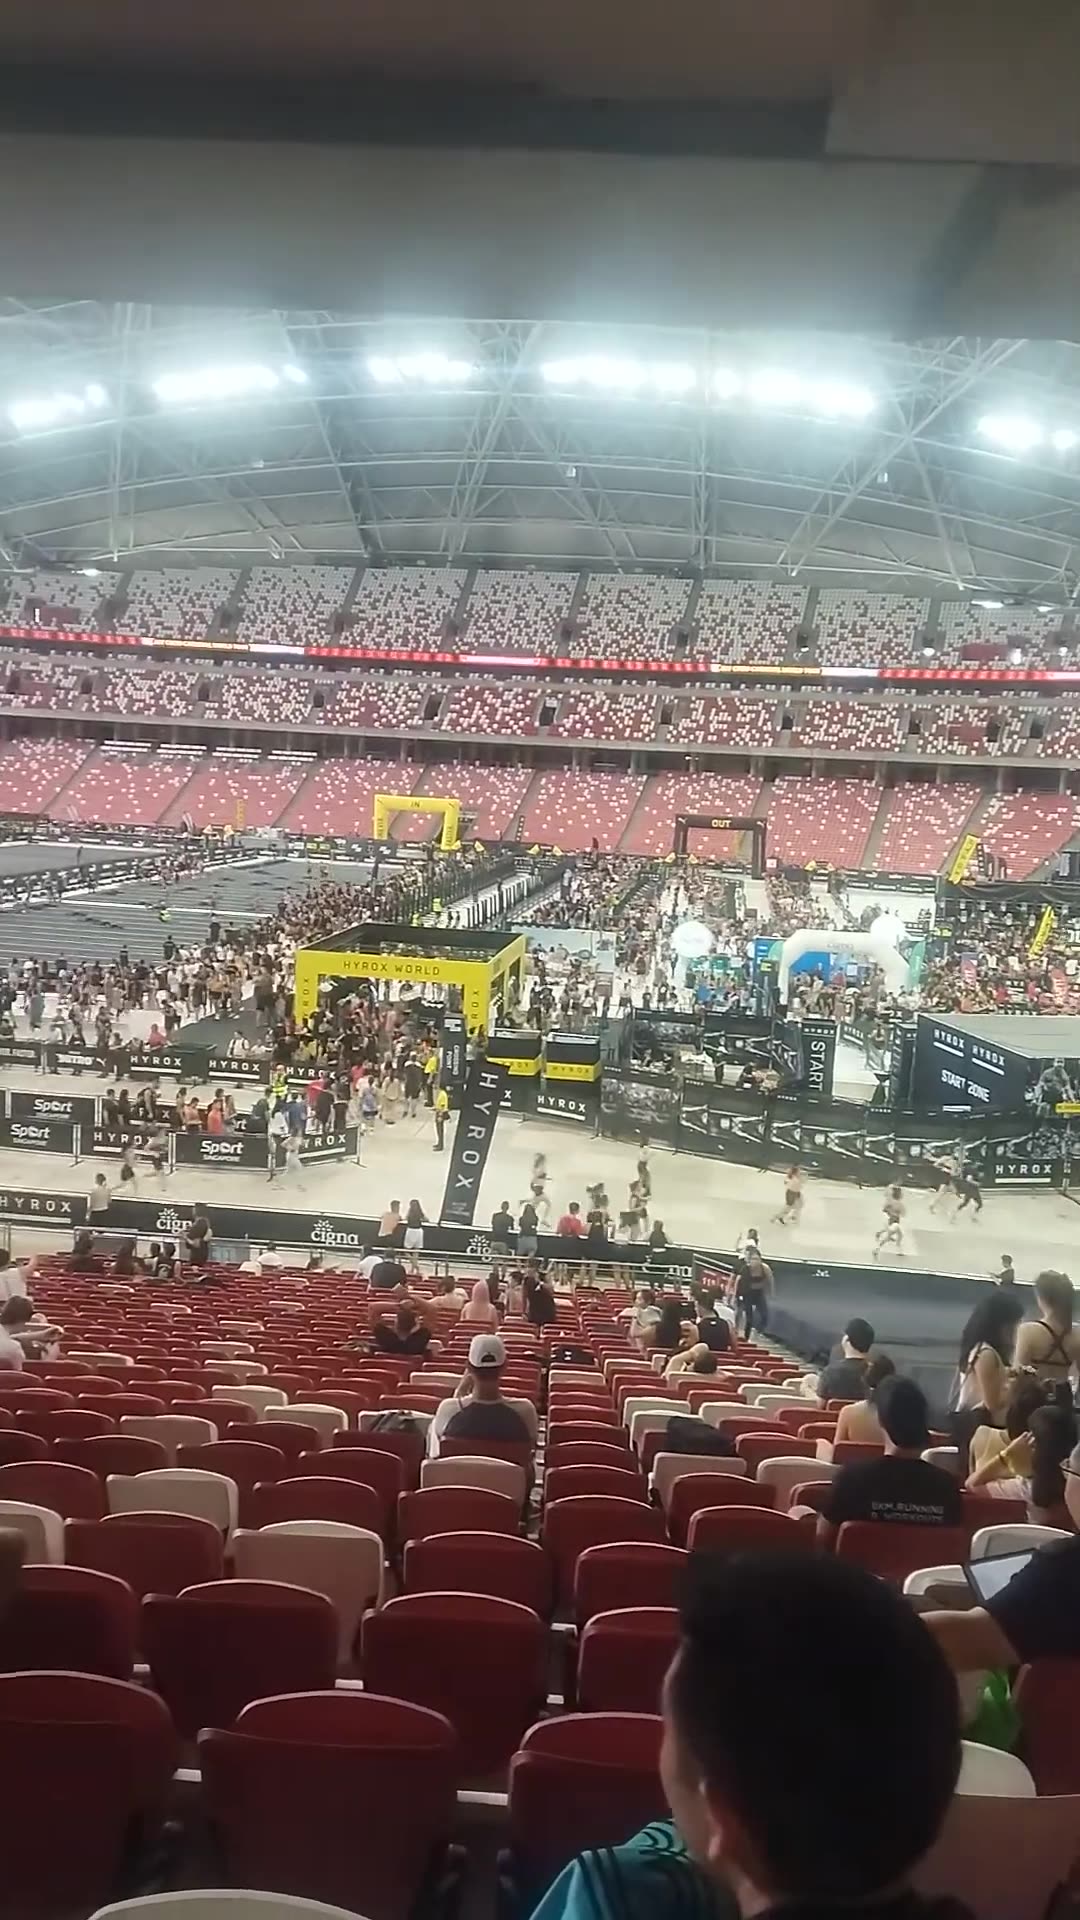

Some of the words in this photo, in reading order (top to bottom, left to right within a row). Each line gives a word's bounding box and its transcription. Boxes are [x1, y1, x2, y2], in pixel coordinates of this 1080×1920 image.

[711, 819, 732, 828] OUT
[343, 960, 388, 972] HYROX
[395, 964, 440, 976] WORLD
[933, 1028, 965, 1049] HYROX
[130, 1055, 182, 1067] HYROX
[971, 1044, 1006, 1067] HYROX
[208, 1059, 261, 1072] HYROX
[808, 1040, 826, 1092] START
[940, 1069, 967, 1089] START
[967, 1080, 991, 1103] ZONE
[33, 1098, 73, 1114] Sport
[537, 1095, 587, 1113] HYROX
[10, 1123, 51, 1139] Sport
[455, 1071, 499, 1189] HYROX
[200, 1139, 245, 1155] Sport
[303, 1134, 347, 1150] YROX
[995, 1164, 1053, 1175] HYROX
[156, 1217, 192, 1234] cign
[311, 1227, 359, 1246] cigna
